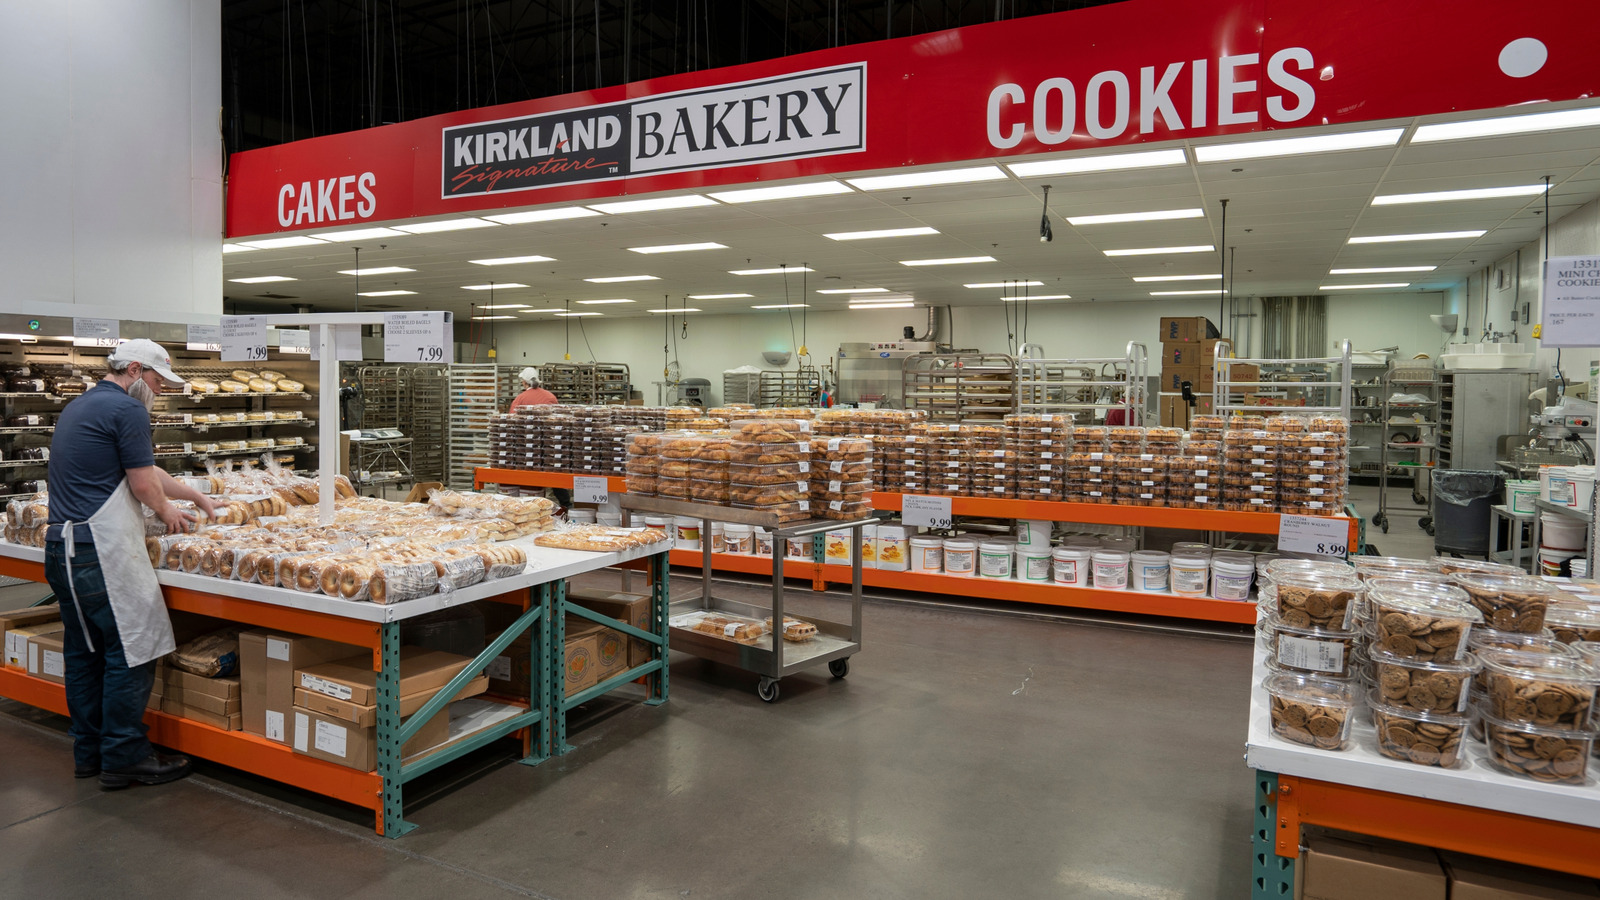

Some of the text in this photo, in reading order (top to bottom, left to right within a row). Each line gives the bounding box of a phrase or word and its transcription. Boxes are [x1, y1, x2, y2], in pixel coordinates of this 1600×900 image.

[986, 47, 1316, 149] COOKIES
[636, 83, 852, 160] BAKERY
[454, 115, 622, 167] KIRKLAND
[452, 157, 619, 193] Signature
[278, 171, 377, 227] CAKES
[1573, 260, 1600, 269] 1331
[1558, 270, 1585, 279] MINI
[96, 337, 119, 346] 15.99
[247, 347, 267, 359] 7.99
[417, 347, 443, 361] 7.99
[592, 494, 608, 503] 9.99
[930, 517, 951, 528] 9.99
[1317, 543, 1346, 555] 8.99
